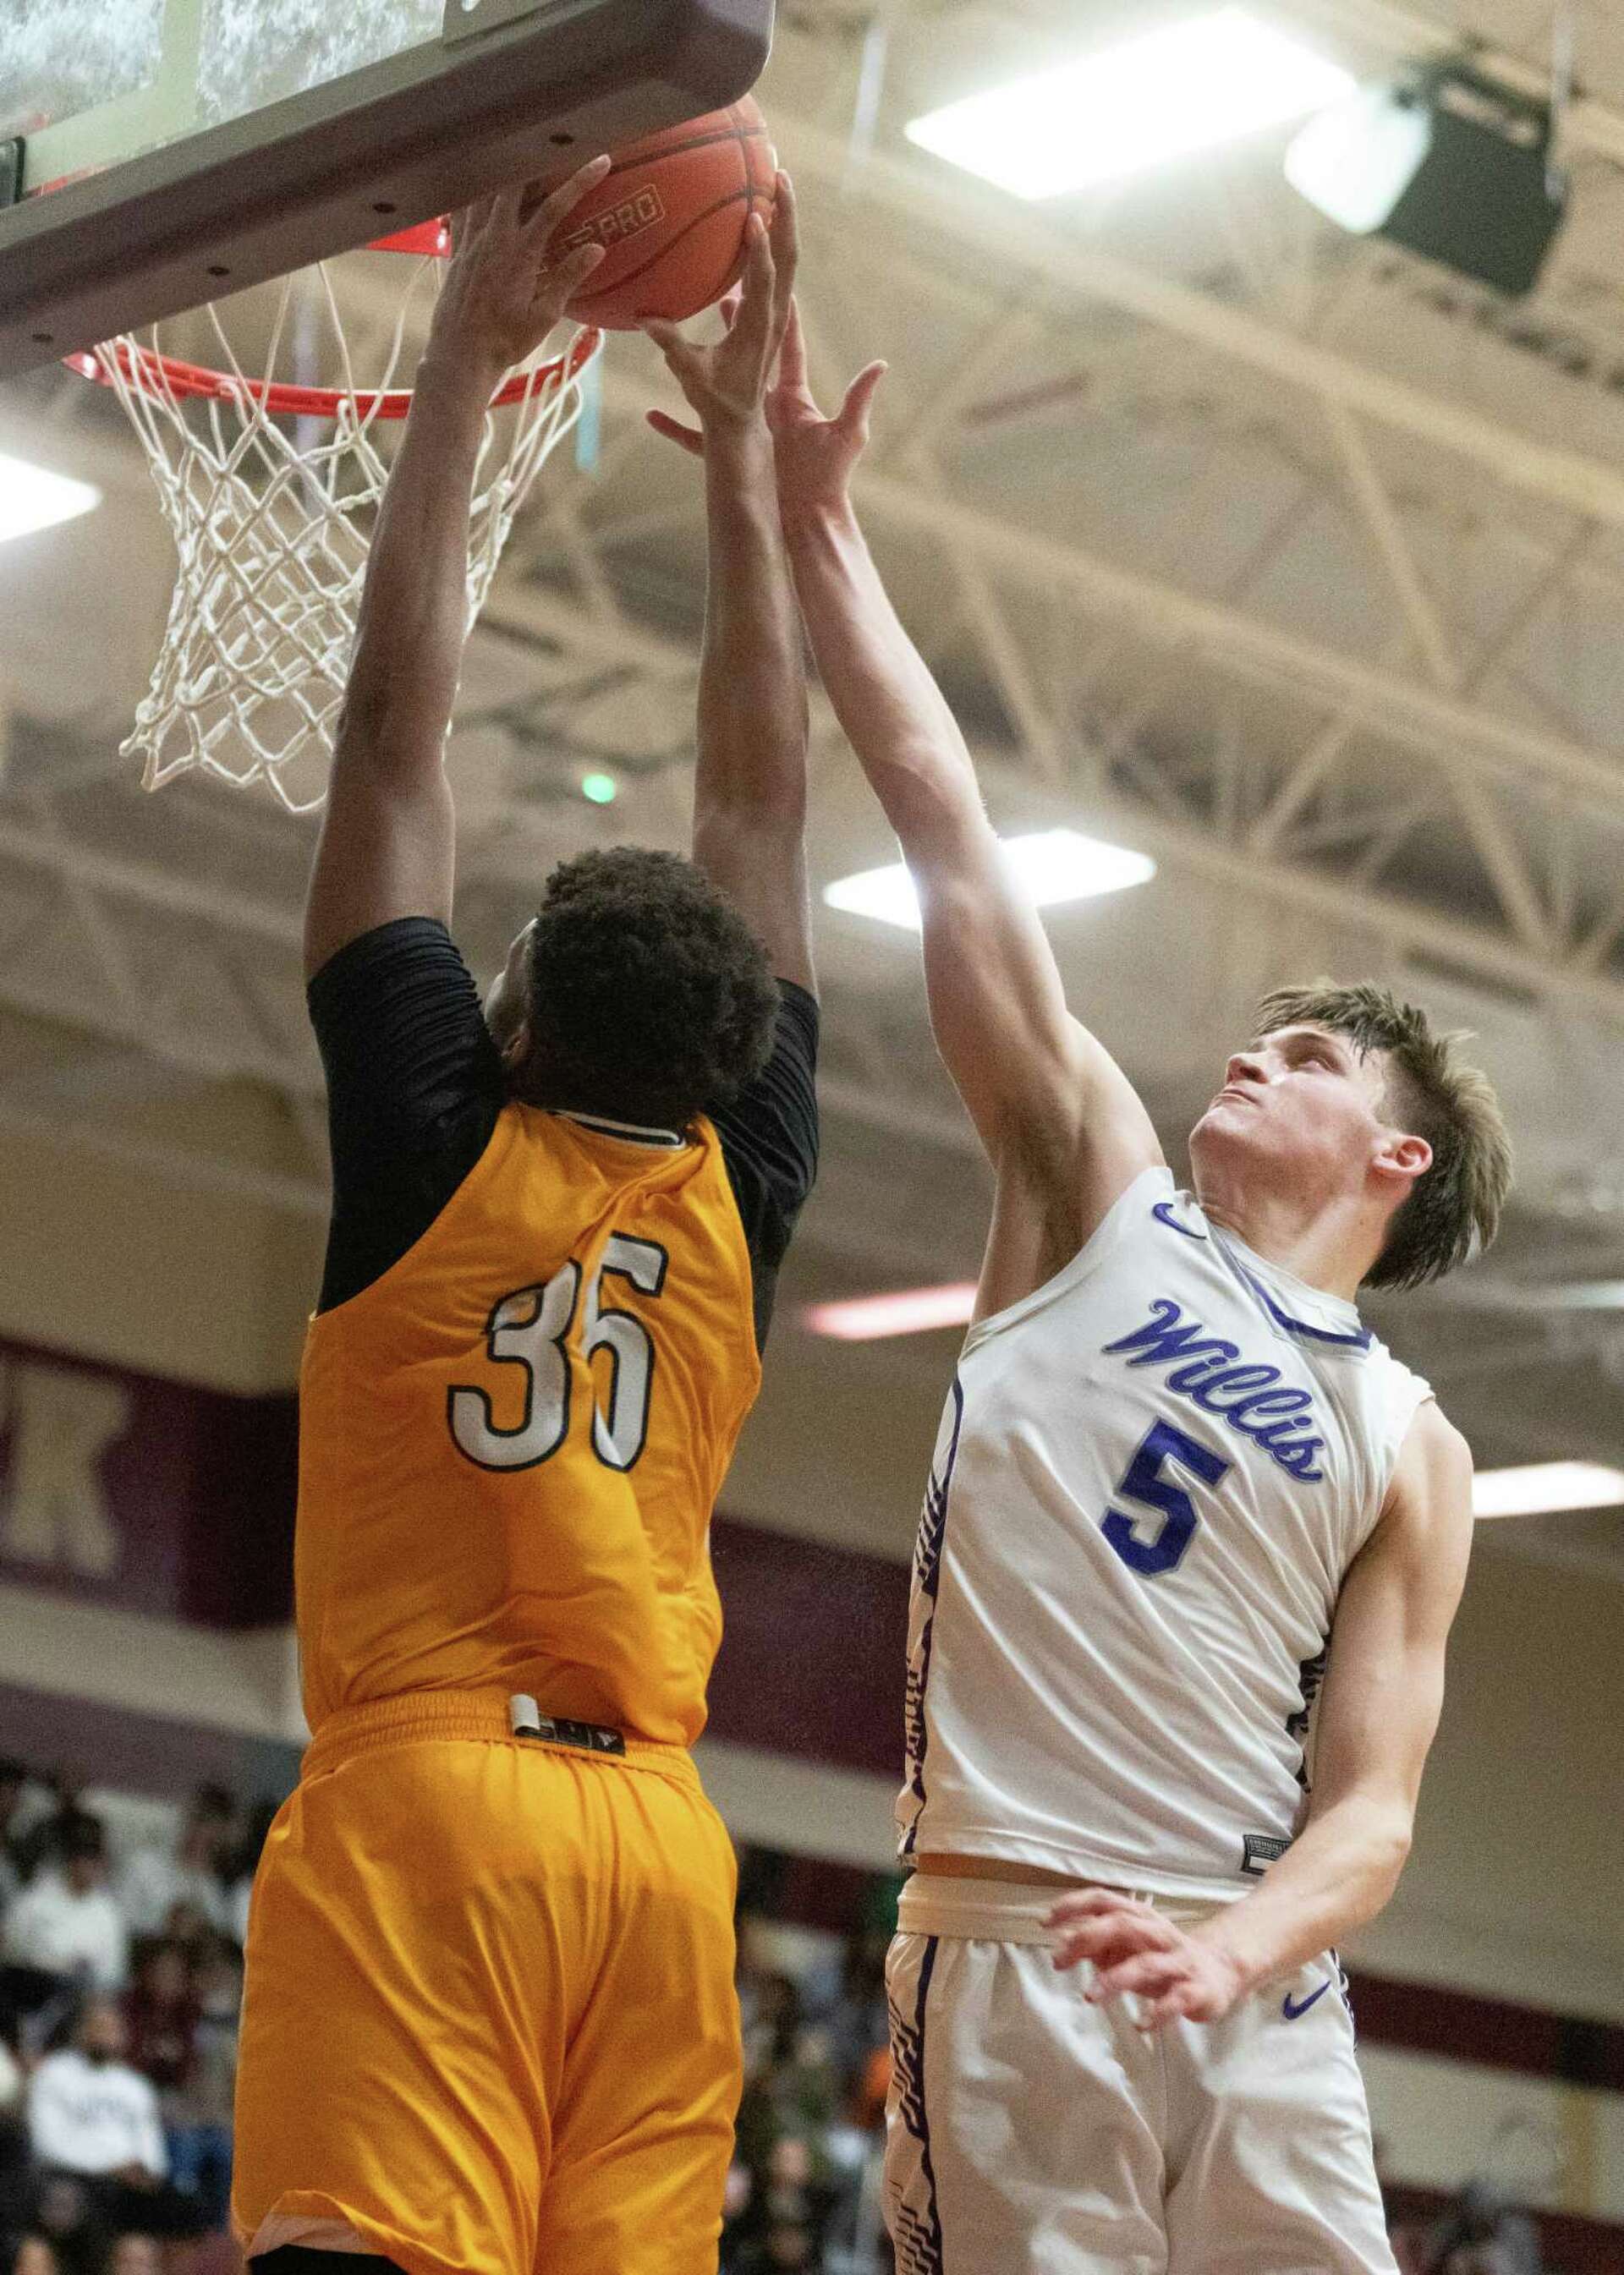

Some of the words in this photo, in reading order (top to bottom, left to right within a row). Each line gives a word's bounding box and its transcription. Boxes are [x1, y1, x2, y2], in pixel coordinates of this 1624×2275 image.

[597, 193, 657, 243] PRO
[447, 1231, 668, 1473] 36
[1101, 1298, 1325, 1483] Willis
[1100, 1417, 1234, 1577] 5
